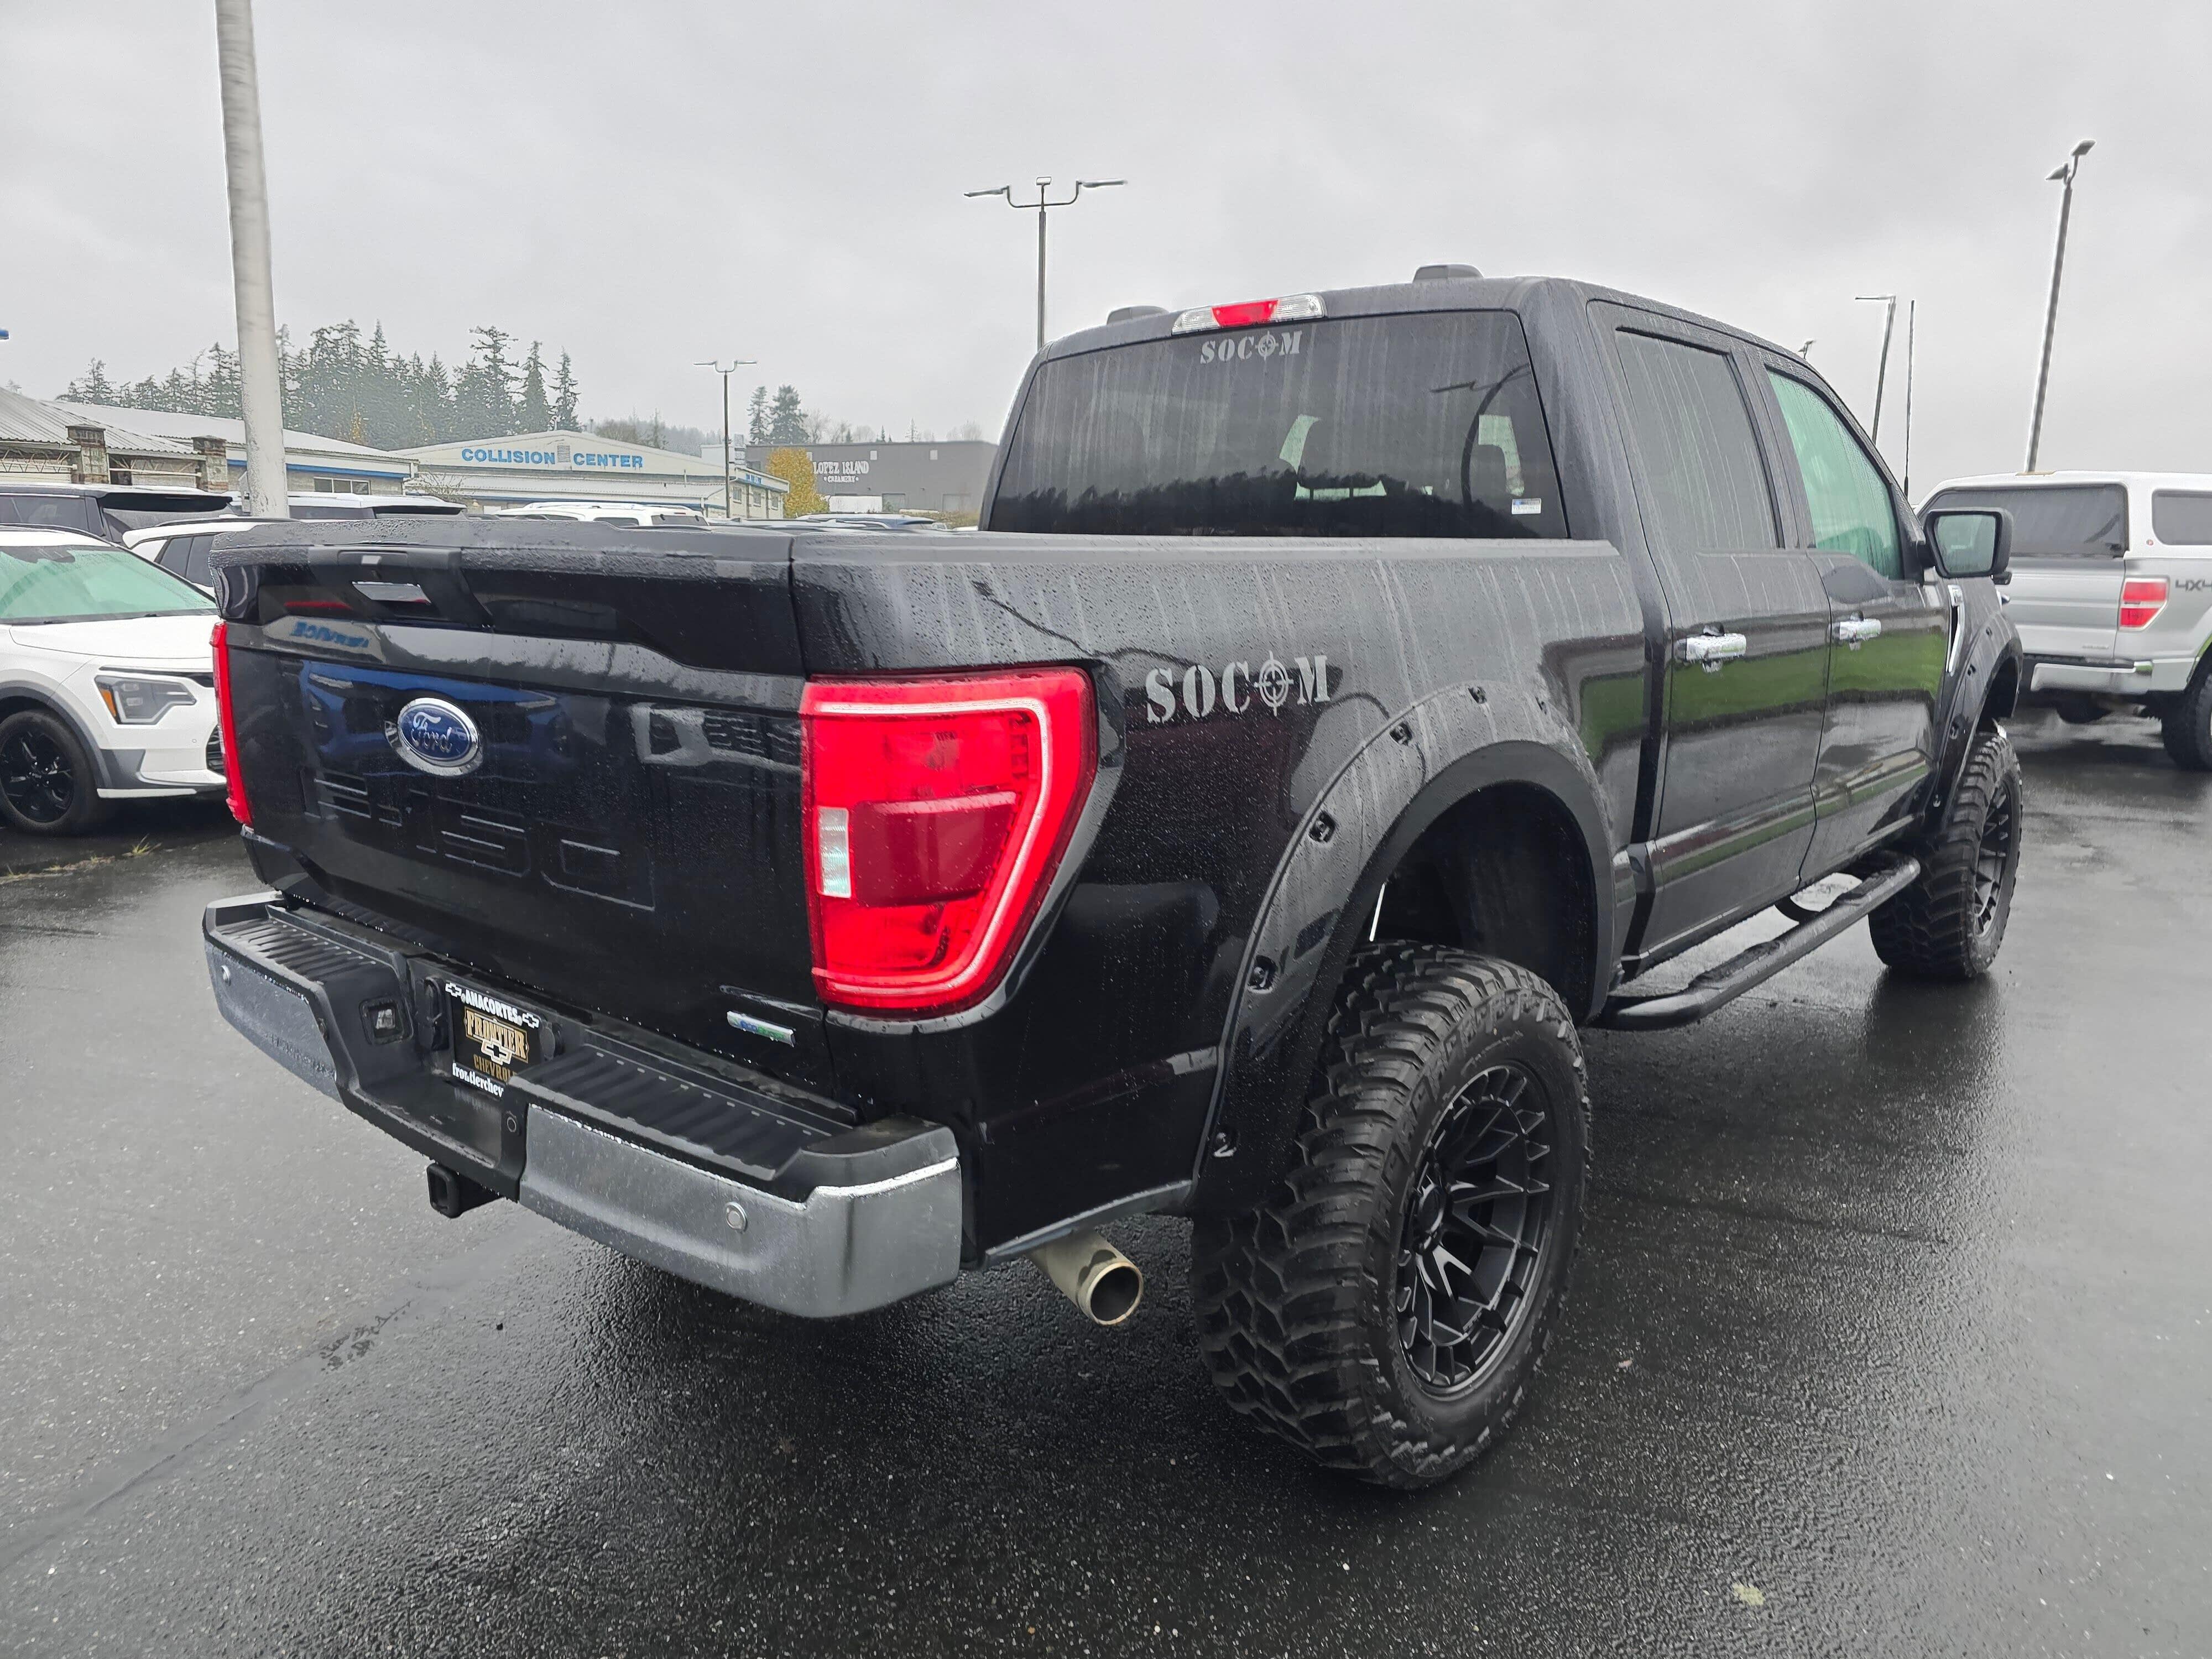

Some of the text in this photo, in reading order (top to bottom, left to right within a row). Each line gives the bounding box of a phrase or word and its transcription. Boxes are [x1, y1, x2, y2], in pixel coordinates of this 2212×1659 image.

[1199, 330, 1302, 364] SOCOM
[461, 448, 643, 468] COLLISION CENTER
[812, 460, 869, 474] LOPEZ ISLAND
[1145, 650, 1331, 723] SOCOM
[410, 711, 453, 753] Ford
[465, 989, 519, 1024] ANACORTES
[466, 1010, 527, 1059] FRONTIER
[452, 1062, 504, 1098] frontierchev
[473, 1053, 517, 1082] CHEVRO
